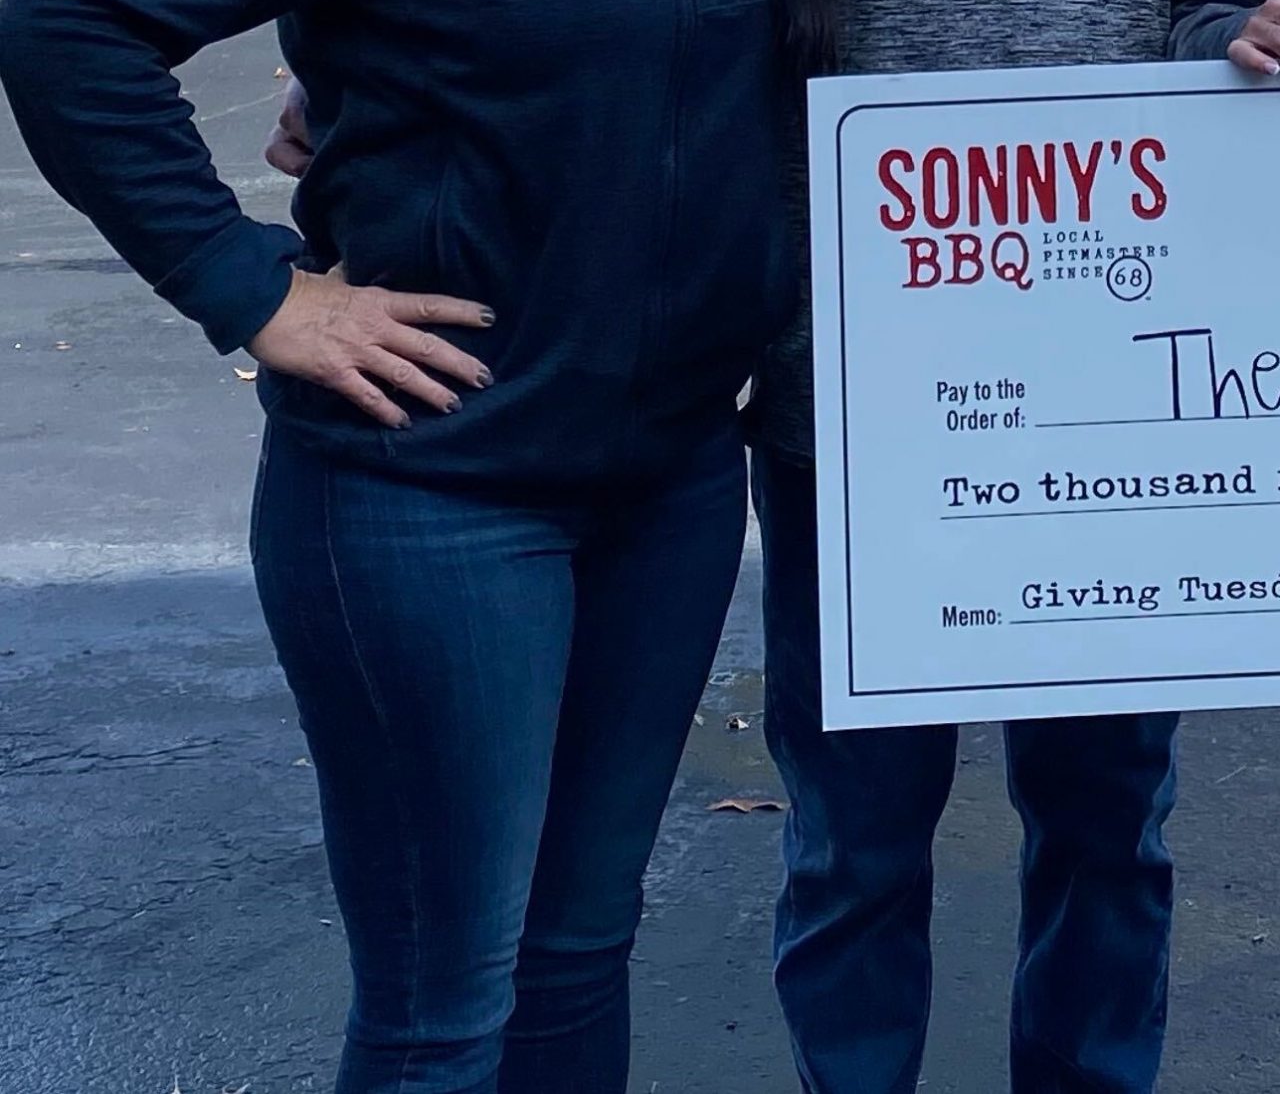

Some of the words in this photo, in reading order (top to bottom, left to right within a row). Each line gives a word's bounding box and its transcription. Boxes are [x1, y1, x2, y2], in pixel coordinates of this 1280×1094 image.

[878, 138, 1167, 231] SONNY'S
[1043, 230, 1103, 244] LOCAL
[901, 231, 1034, 291] BBQ
[1043, 245, 1168, 262] PITMASTERS
[1043, 266, 1103, 280] SINCE
[1114, 267, 1143, 287] 68
[937, 381, 969, 407] Pay
[974, 381, 991, 401] to
[996, 378, 1026, 399] the
[947, 409, 996, 431] Order
[1002, 406, 1026, 428] of:
[943, 477, 1020, 507] Two
[1038, 465, 1256, 501] thousand
[942, 606, 1002, 629] Memo:
[1022, 579, 1160, 611] Giving
